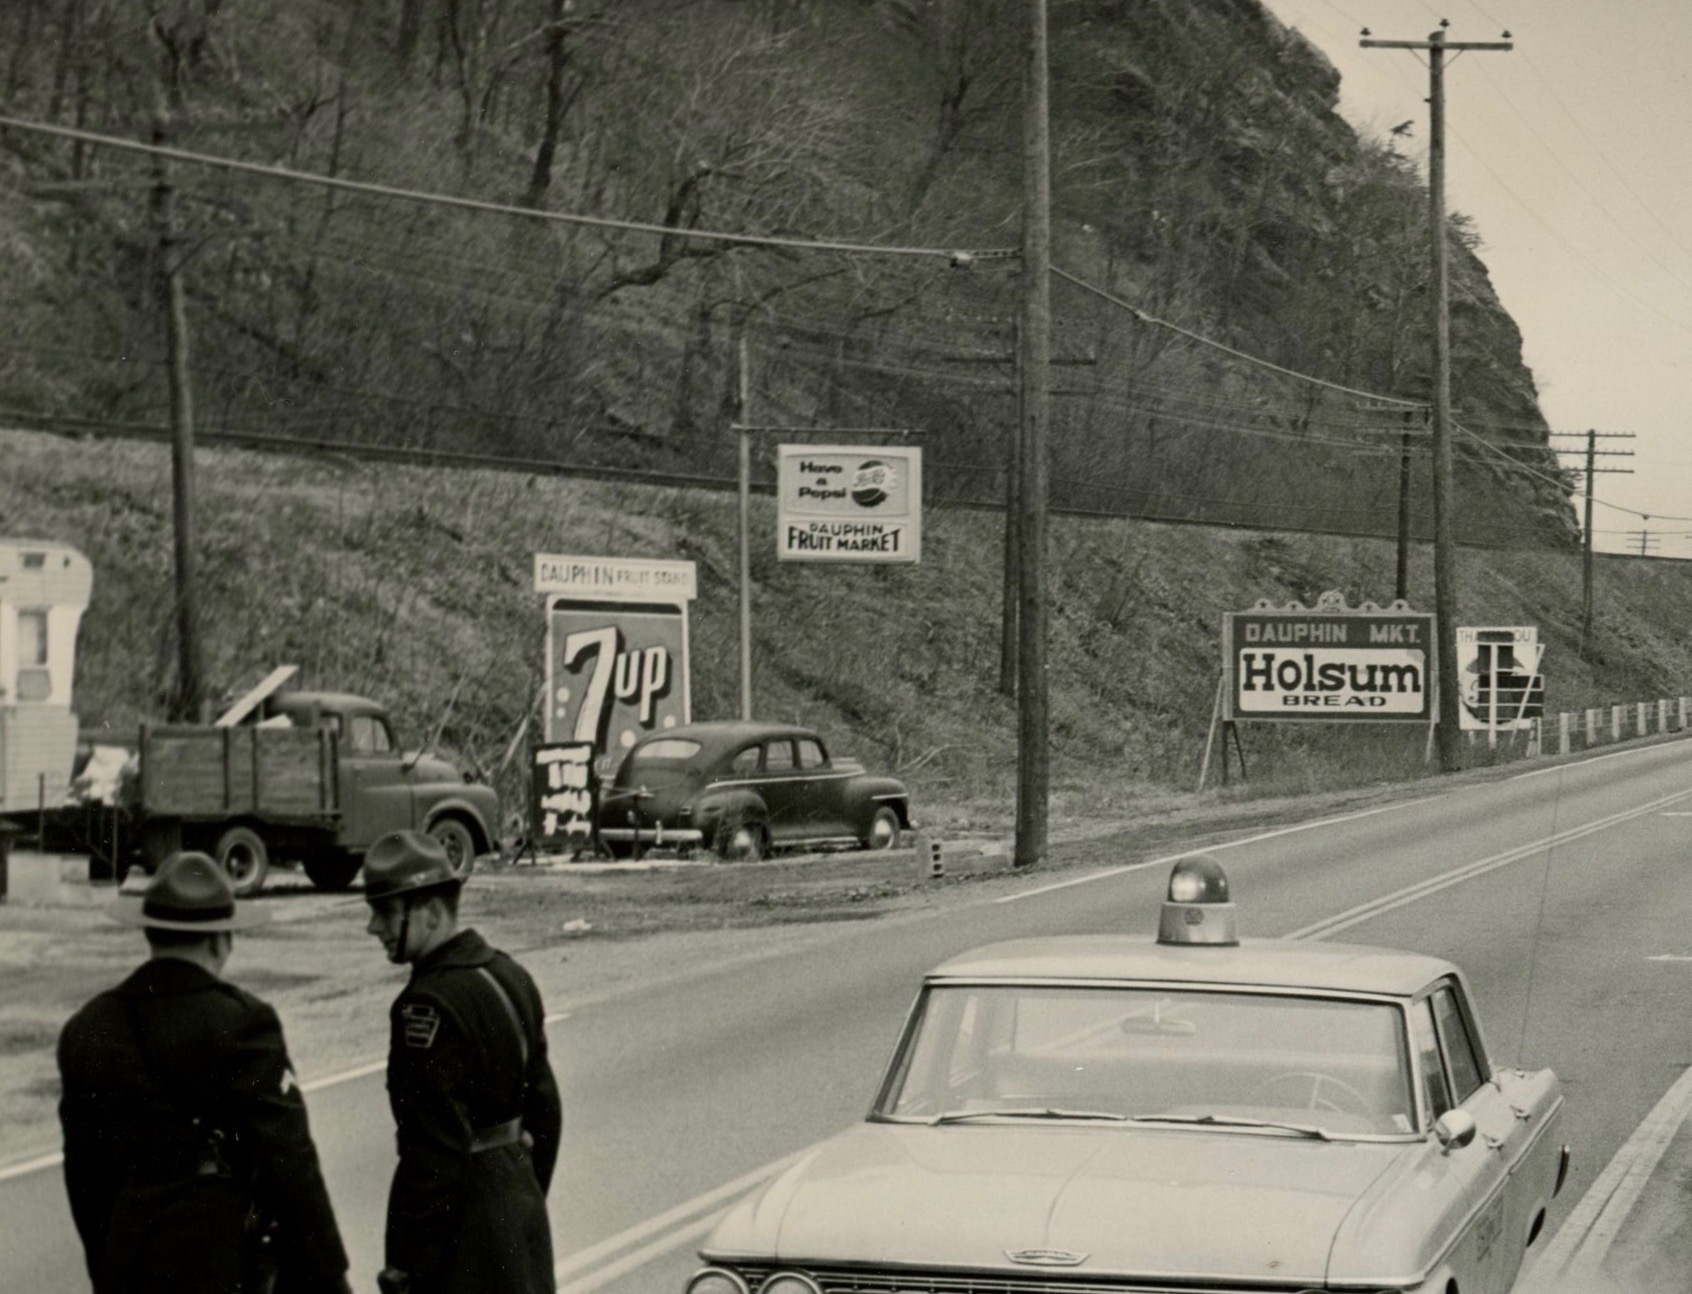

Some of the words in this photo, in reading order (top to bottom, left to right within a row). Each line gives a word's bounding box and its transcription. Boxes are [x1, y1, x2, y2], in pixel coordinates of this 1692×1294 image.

[800, 461, 842, 473] Have
[816, 477, 827, 486] a
[799, 486, 846, 500] Pepsi
[810, 523, 883, 536] DAUPHIN
[787, 526, 832, 550] FRUIT
[837, 528, 901, 552] MARKET
[540, 563, 614, 585] DAUPHIN
[1245, 623, 1347, 643] DAUPHIN
[1369, 623, 1421, 644] MKT.
[1243, 653, 1421, 693] Holsum
[1282, 695, 1387, 707] BREAD
